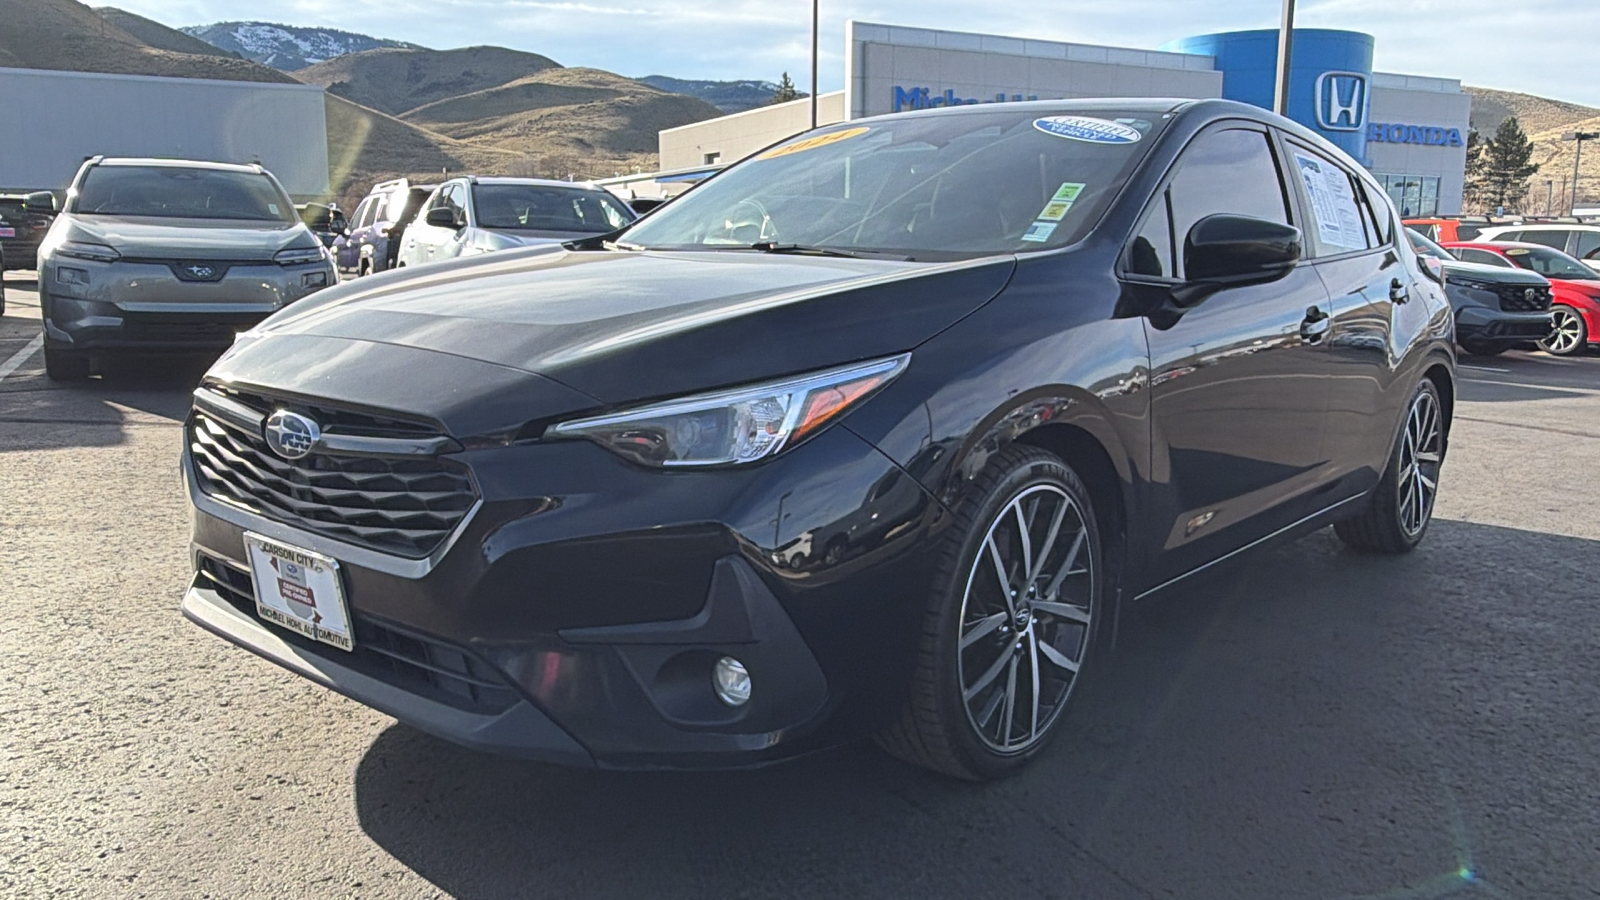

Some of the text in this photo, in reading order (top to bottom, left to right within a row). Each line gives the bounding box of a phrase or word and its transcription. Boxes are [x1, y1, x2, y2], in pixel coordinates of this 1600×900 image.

[892, 86, 1006, 112] Mich
[1368, 122, 1464, 146] HONDA
[263, 542, 315, 569] CARSON CITY
[259, 605, 286, 625] MICHAEL
[286, 616, 303, 631] HOHL
